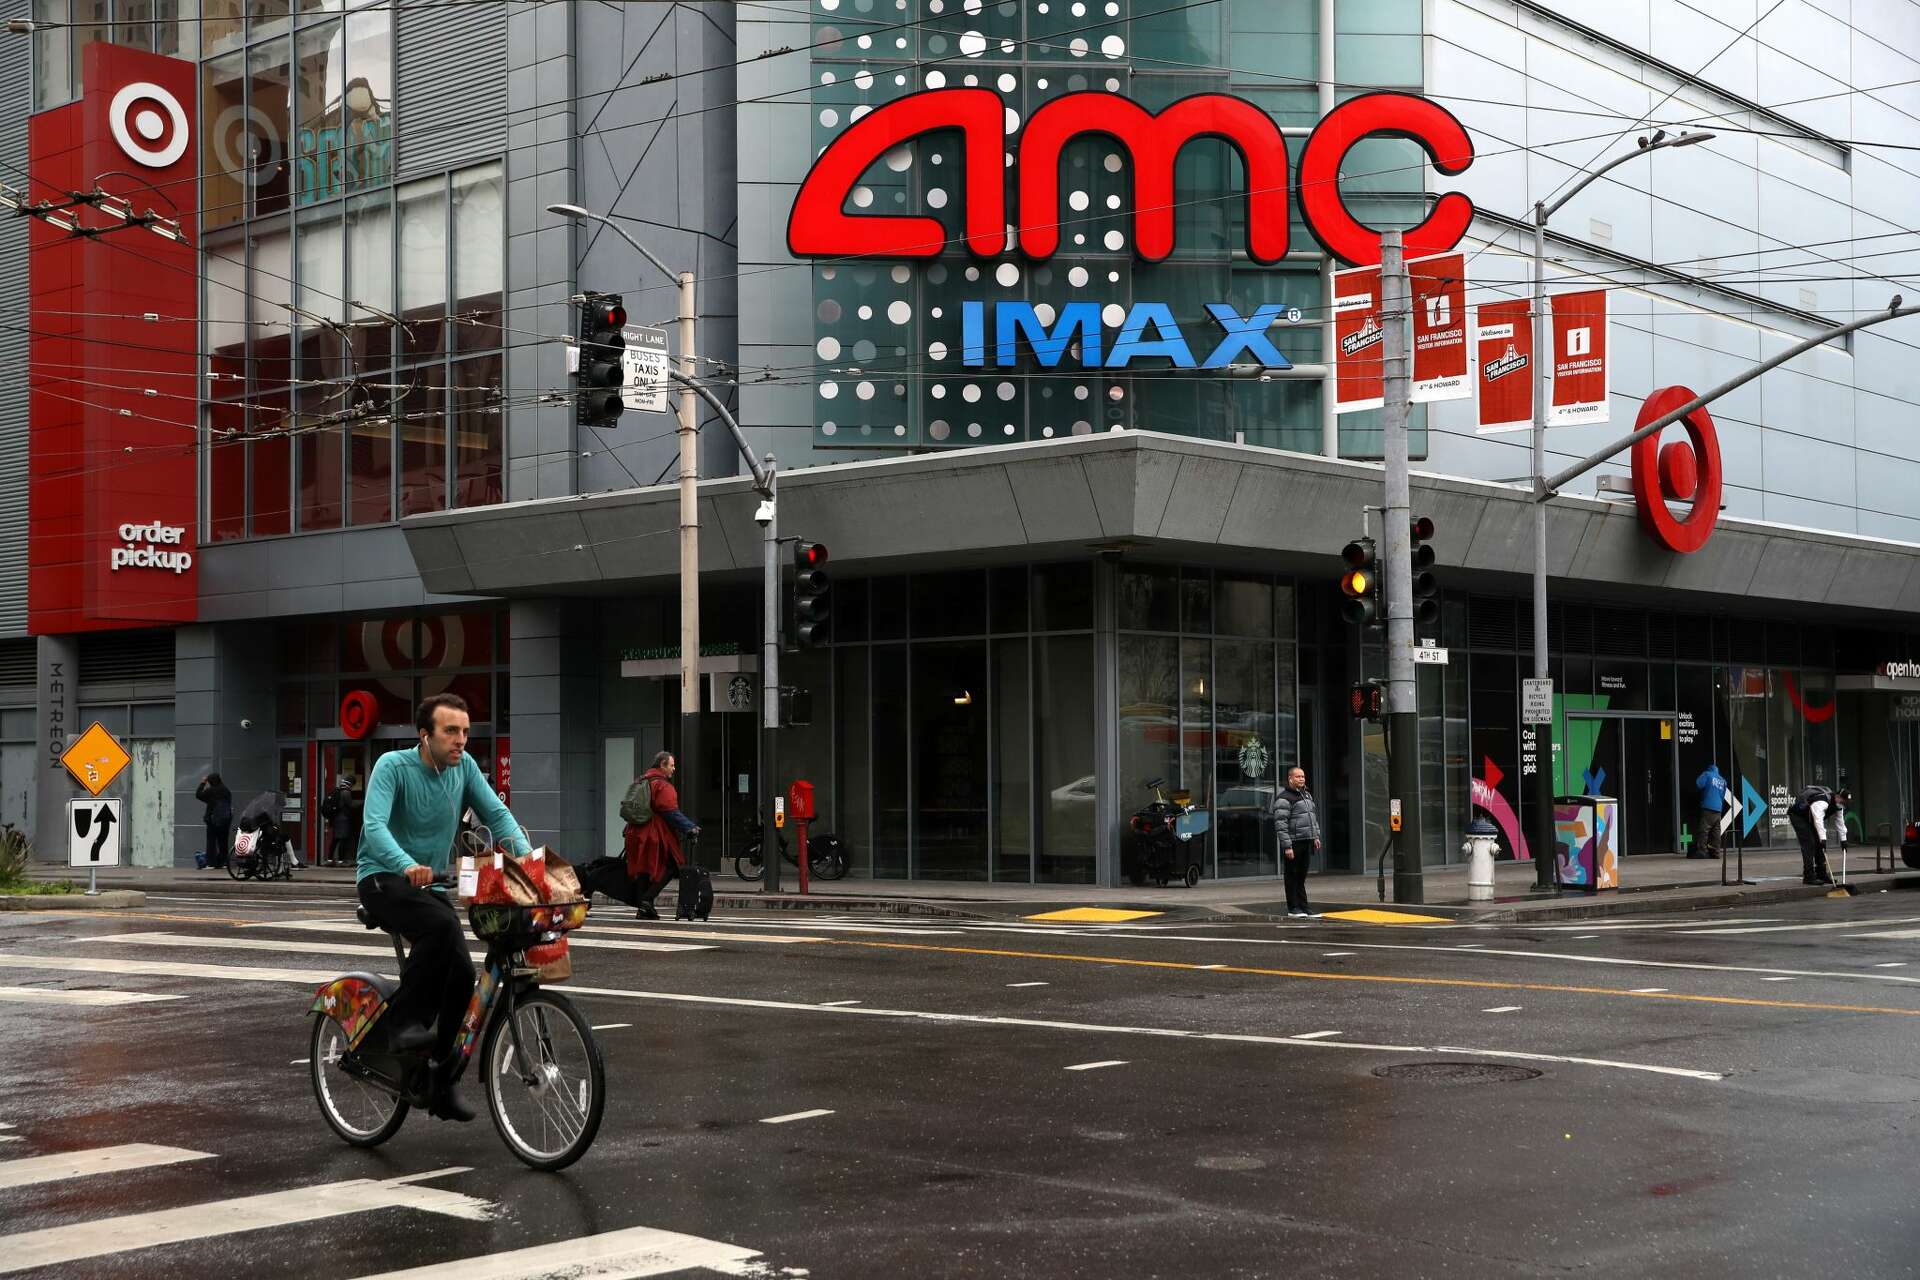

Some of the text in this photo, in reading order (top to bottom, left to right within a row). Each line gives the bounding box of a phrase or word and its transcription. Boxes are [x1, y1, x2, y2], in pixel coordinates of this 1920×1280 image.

[623, 331, 665, 345] RIGHT LANE
[1343, 334, 1358, 348] SAN
[1417, 329, 1462, 343] SAN FRANCISCO
[630, 350, 660, 363] BUSES
[634, 363, 659, 376] TAXIS
[1486, 357, 1526, 380] SAN FRANCISCO
[1557, 358, 1602, 371] SAN FRANCISCO
[1434, 380, 1460, 389] HOWARD
[1572, 405, 1599, 413] HOWARD
[119, 520, 186, 545] order
[111, 543, 192, 574] pickup
[1432, 651, 1439, 661] ST
[1887, 662, 1909, 680] open
[50, 663, 63, 769] METREON
[1678, 712, 1692, 720] Unlock
[1679, 720, 1695, 728] exciting
[1523, 764, 1536, 775] glob
[1770, 784, 1788, 796] A play
[1771, 794, 1796, 806] space for
[1771, 806, 1788, 815] tomor
